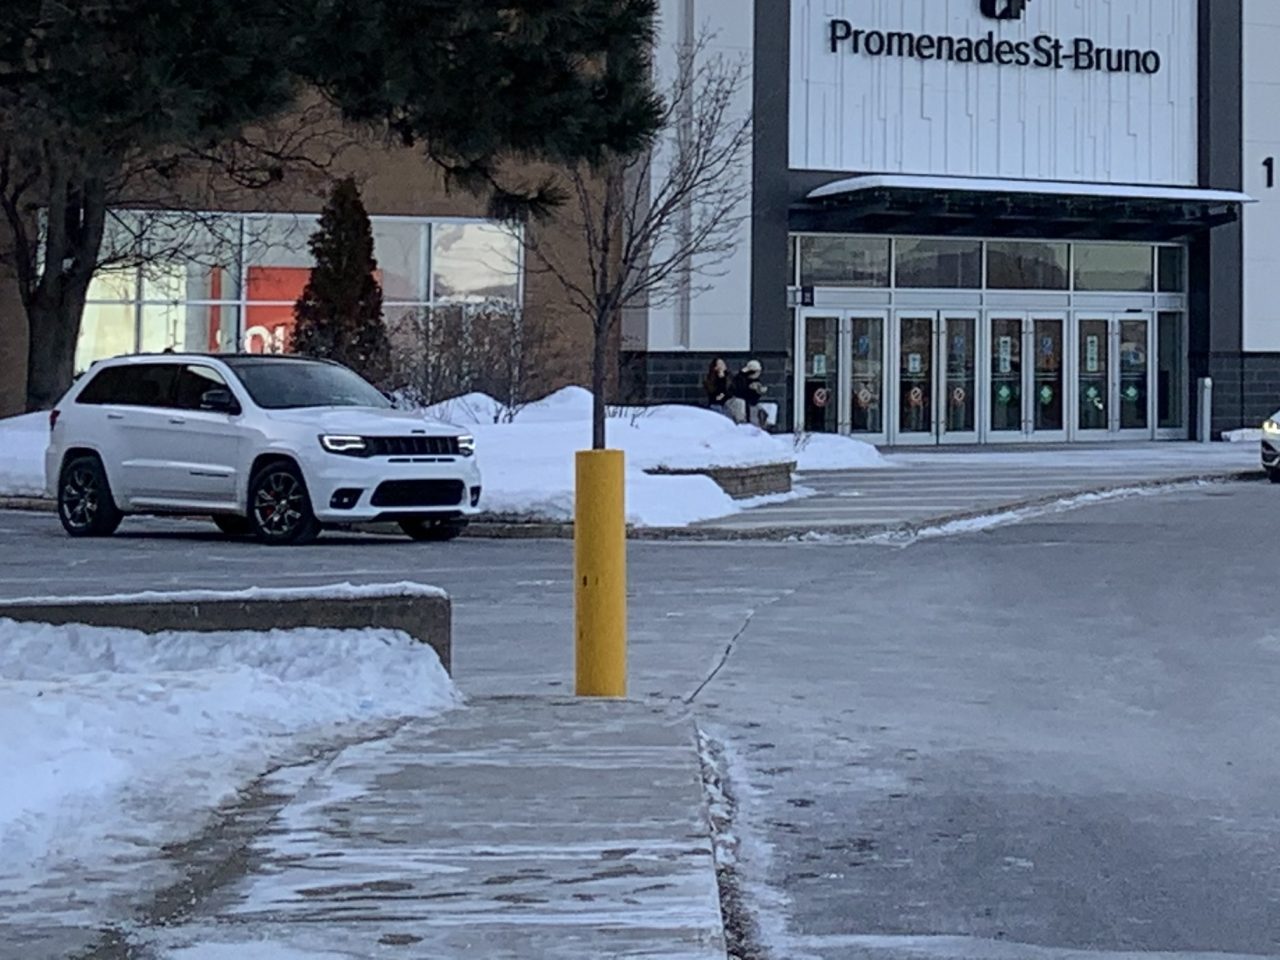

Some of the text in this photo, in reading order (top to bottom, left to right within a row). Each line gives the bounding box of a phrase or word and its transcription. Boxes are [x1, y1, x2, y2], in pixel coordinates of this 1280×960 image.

[829, 19, 1161, 75] Promenades St-Bruno
[1262, 156, 1274, 189] 1
